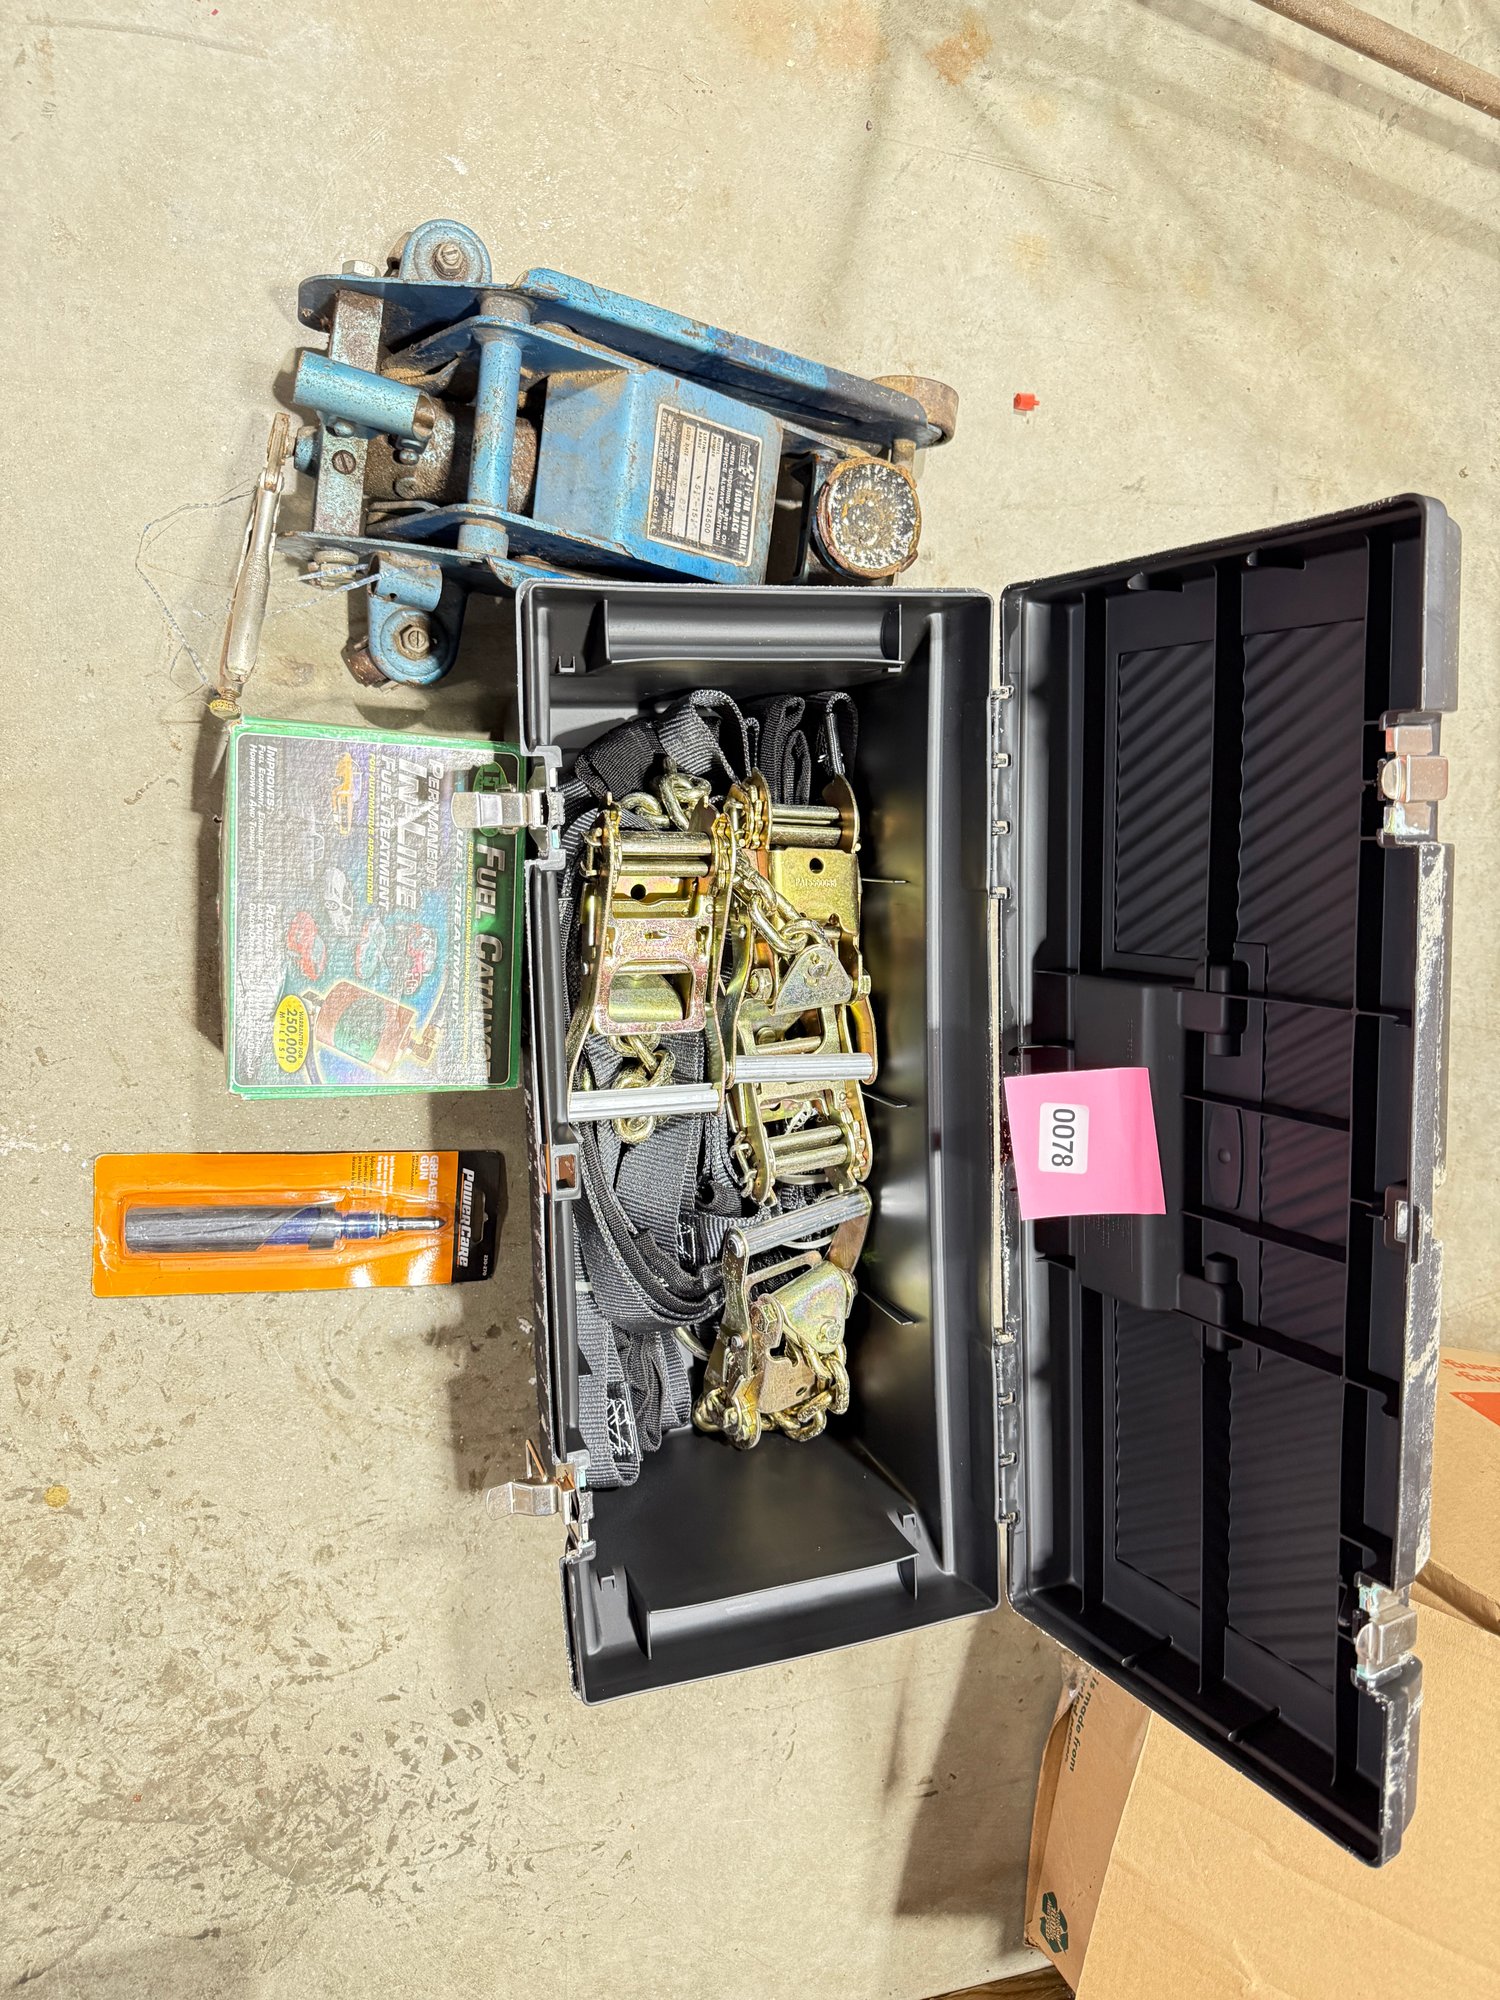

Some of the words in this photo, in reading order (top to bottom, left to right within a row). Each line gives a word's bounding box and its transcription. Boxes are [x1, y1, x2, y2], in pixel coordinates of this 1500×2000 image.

[656, 441, 665, 477] ROEBUCK
[722, 442, 730, 473] SERVICE
[729, 445, 737, 466] WHEN
[669, 499, 675, 508] IN
[718, 476, 726, 505] ALWAYS
[725, 468, 734, 504] ORDERING
[733, 489, 743, 513] FLOOR
[743, 496, 752, 512] TON
[704, 486, 715, 534] 214.124500
[715, 508, 724, 541] MENTION
[722, 508, 730, 531] PARTS
[731, 513, 741, 534] JACK
[721, 534, 727, 545] OR
[738, 515, 749, 557] HYDRAULIC
[249, 743, 257, 798] HORSEPOWER
[258, 744, 266, 764] FUEL
[368, 753, 376, 772] FOR
[266, 745, 277, 811] IMPROVES:
[380, 754, 396, 803] FUEL
[249, 799, 257, 818] AND
[367, 774, 375, 835] AUTOMOTIVE
[427, 759, 444, 888] PERMANENT
[378, 806, 395, 912] TREATMENT
[455, 828, 464, 873] UEL
[366, 837, 374, 905] APPLICATIONS
[475, 843, 505, 919] FUEL
[451, 882, 463, 1025] TREATMENT
[285, 1008, 298, 1063] 250,000
[1051, 1108, 1076, 1167] 0078
[419, 1155, 429, 1180] GUN
[428, 1155, 439, 1201] GREASE
[458, 1168, 475, 1267] PowerCare
[1089, 1677, 1099, 1690] is
[1075, 1691, 1093, 1734] made
[1069, 1736, 1081, 1772] from
